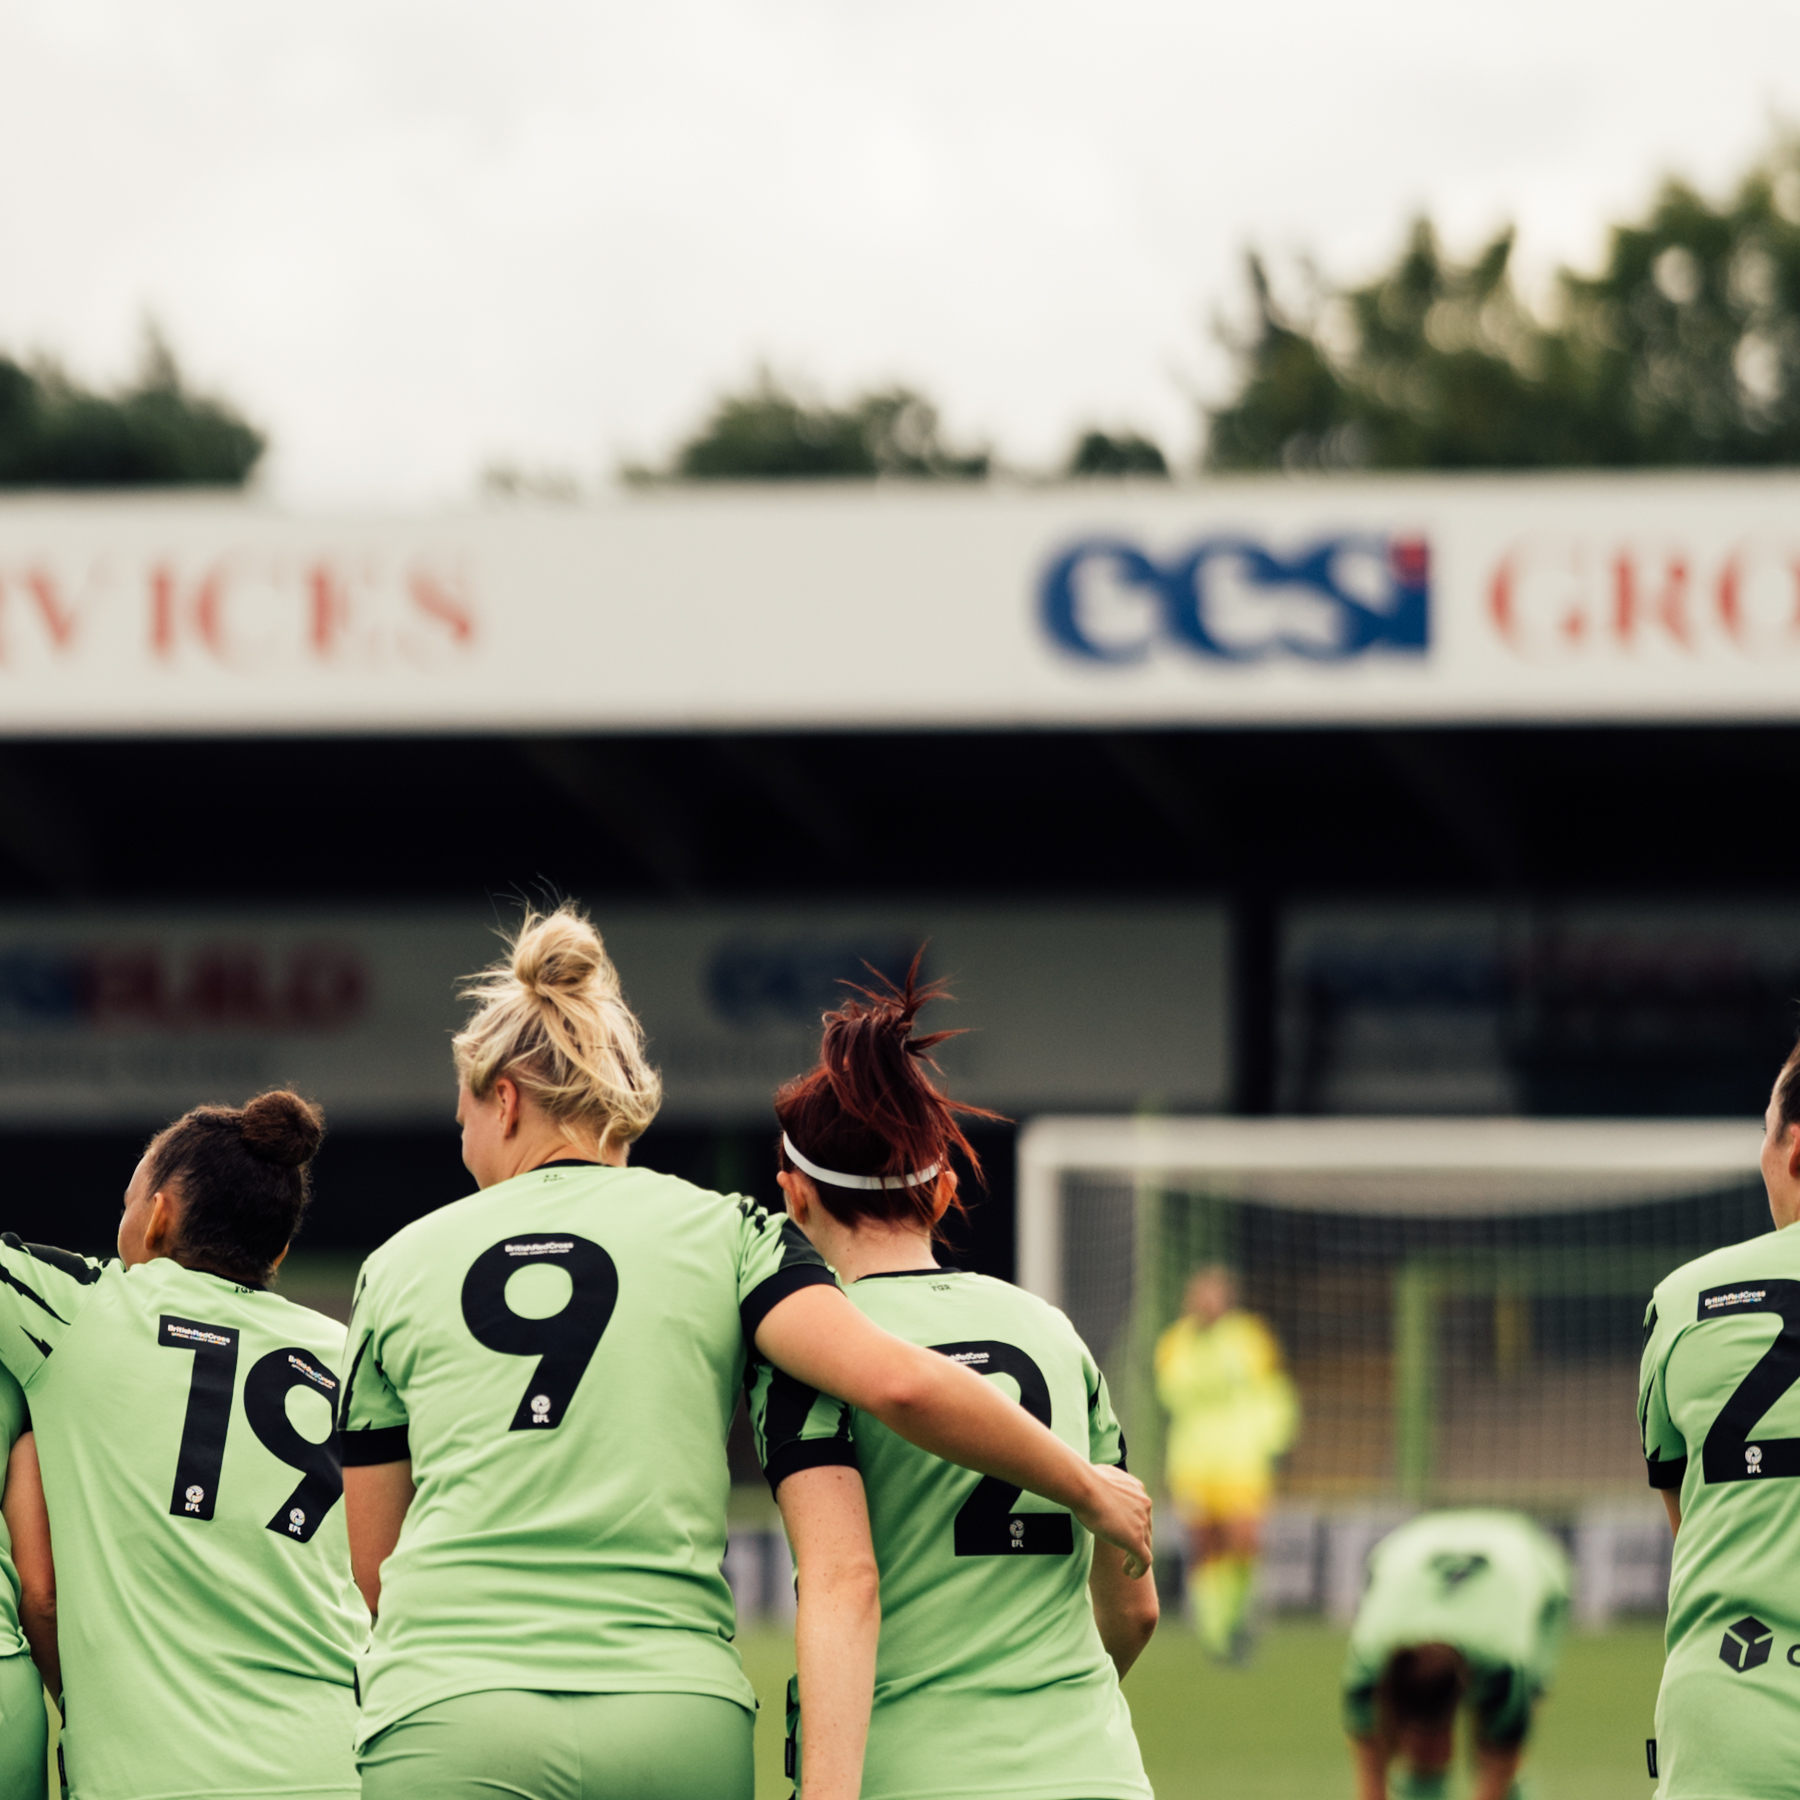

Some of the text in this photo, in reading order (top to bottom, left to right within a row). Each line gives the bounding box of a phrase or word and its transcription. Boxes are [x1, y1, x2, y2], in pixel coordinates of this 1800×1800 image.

[504, 1241, 574, 1253] BritishRedCross
[1704, 1289, 1767, 1307] BritishRedCross
[167, 1324, 231, 1344] BritishRedCross
[461, 1232, 619, 1431] 9
[532, 1412, 549, 1424] EFL
[157, 1314, 343, 1544] 19
[924, 1340, 1074, 1557] 2
[1747, 1464, 1762, 1474] EFL
[184, 1502, 201, 1513] EFL
[288, 1523, 303, 1536] EFL
[1011, 1539, 1024, 1548] EFL
